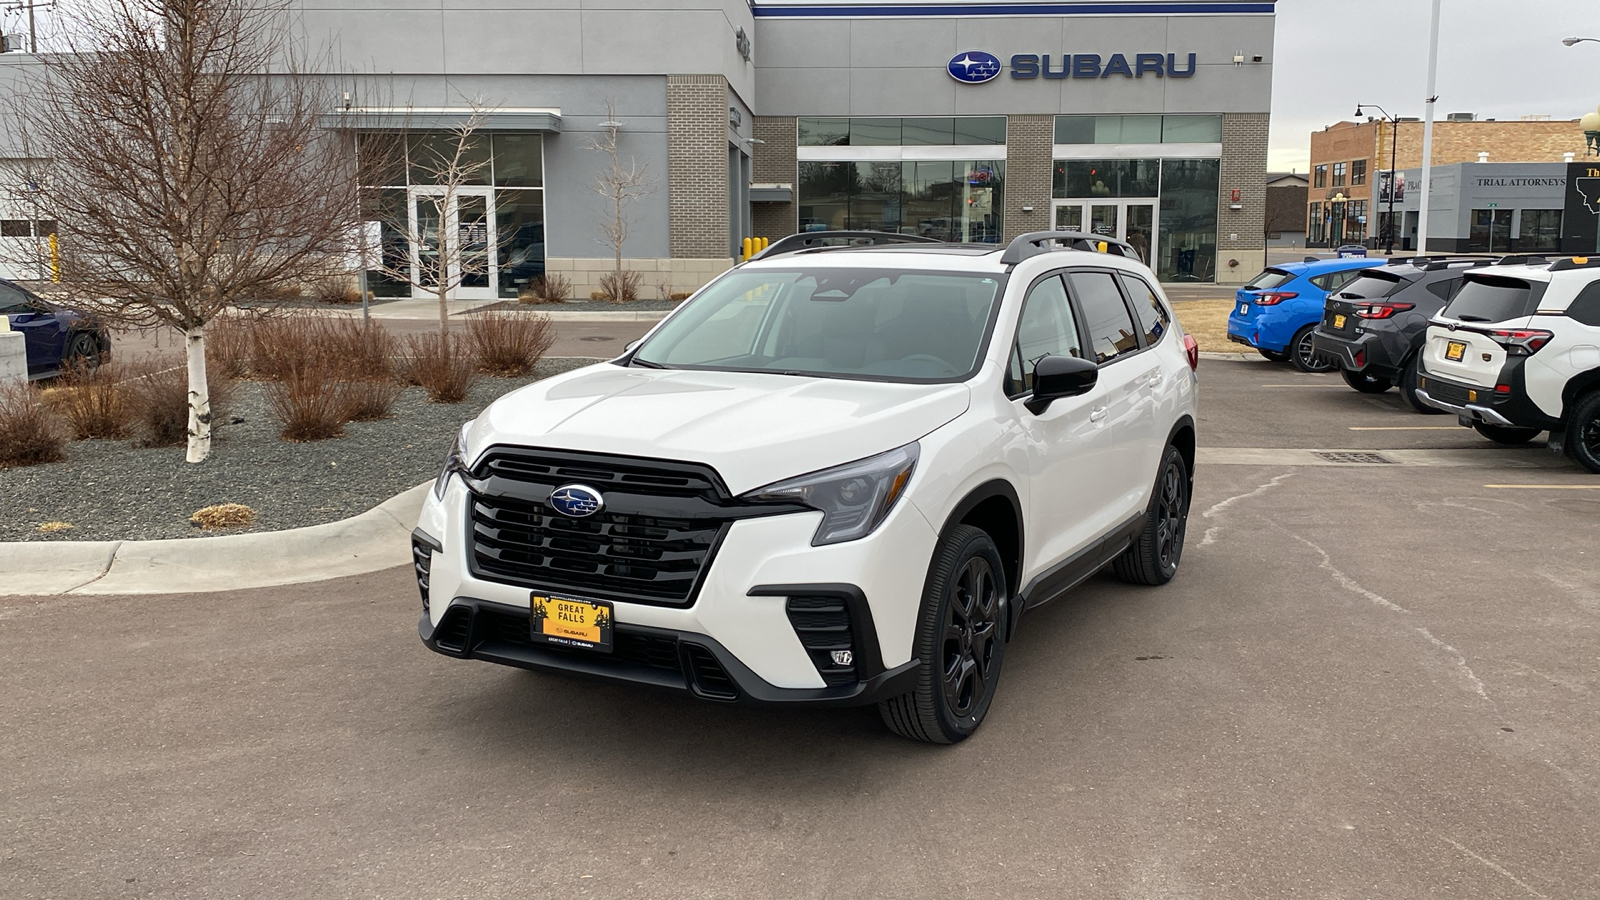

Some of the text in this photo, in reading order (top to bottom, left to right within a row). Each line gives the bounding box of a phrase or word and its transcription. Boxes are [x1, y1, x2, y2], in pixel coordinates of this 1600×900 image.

[1010, 53, 1196, 79] SUBARU
[1407, 179, 1434, 191] PRACE
[1477, 178, 1566, 187] TRIAL ATTORNEYS
[558, 603, 585, 614] GREAT
[558, 612, 585, 624] FALLS
[563, 629, 588, 637] SUBARU
